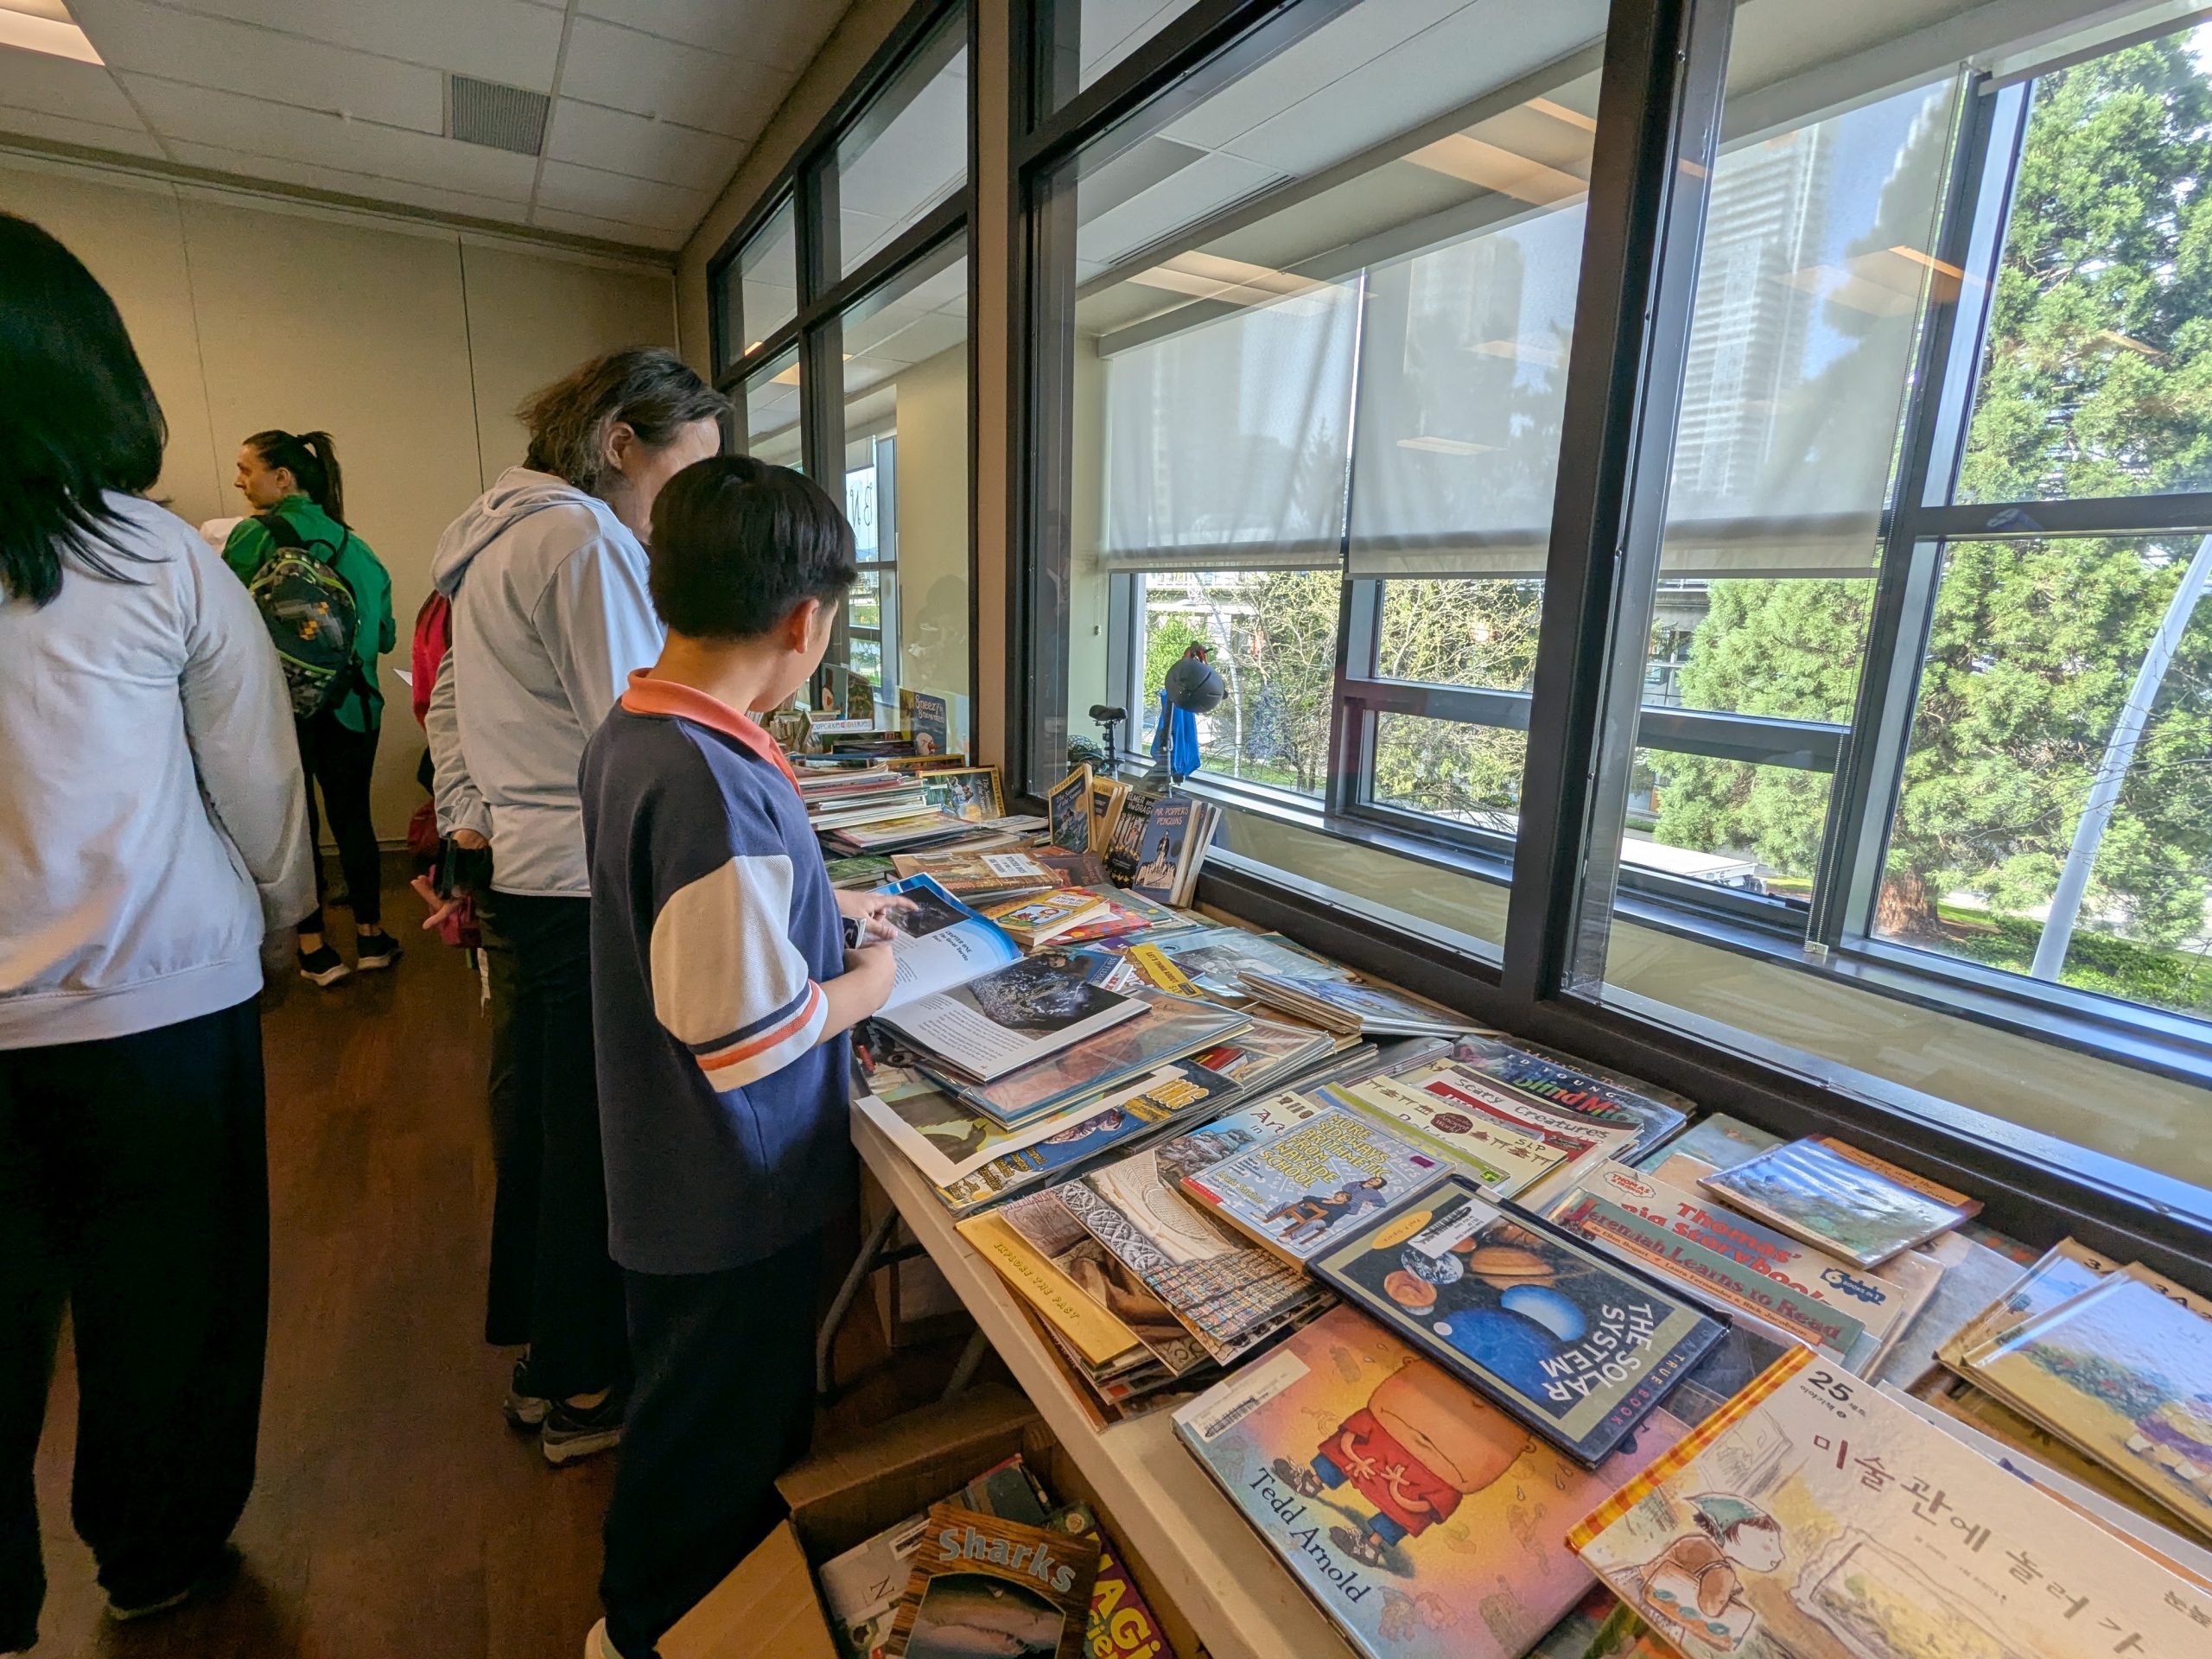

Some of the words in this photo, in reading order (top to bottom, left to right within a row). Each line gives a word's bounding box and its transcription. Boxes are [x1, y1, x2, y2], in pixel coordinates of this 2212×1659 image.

[1127, 792, 1146, 804] ELMER
[1157, 817, 1183, 825] PENGUINS
[1542, 1066, 1617, 1098] YOUNG
[1249, 1109, 1285, 1134] Art
[1328, 1113, 1374, 1141] MORE
[1454, 1078, 1504, 1104] Scary
[1514, 1106, 1611, 1139] Creatures
[1250, 1124, 1262, 1135] in
[1286, 1135, 1331, 1164] FROM
[1317, 1121, 1389, 1164] SIDEWAYS
[1257, 1150, 1319, 1189] SCHOOL
[1274, 1142, 1340, 1185] WAYSIDE
[1301, 1128, 1393, 1179] ARITHMETIC
[1611, 1173, 1651, 1194] THOMAS
[1602, 1230, 1621, 1243] Ellen
[1677, 1202, 1802, 1263] Thomas'
[993, 1243, 1033, 1277] EXPLORE
[1034, 1278, 1052, 1296] THE
[1052, 1296, 1081, 1321] PAST
[1567, 1198, 1666, 1255] Jeremiah
[1668, 1247, 1745, 1294] Learns
[1749, 1289, 1772, 1306] to
[1776, 1299, 1840, 1339] Read
[1538, 1304, 1625, 1378] SYSTEM
[1626, 1303, 1654, 1351] THE
[1541, 1351, 1642, 1402] SOLAR
[1651, 1353, 1686, 1385] TRUE
[1808, 1370, 1854, 1402] 25
[1611, 1389, 1650, 1425] BOOK
[1813, 1434, 1992, 1553] 미술관에
[1249, 1467, 1305, 1526] Tedd
[1290, 1529, 1371, 1605] Arnold
[939, 1526, 1077, 1592] Sharks
